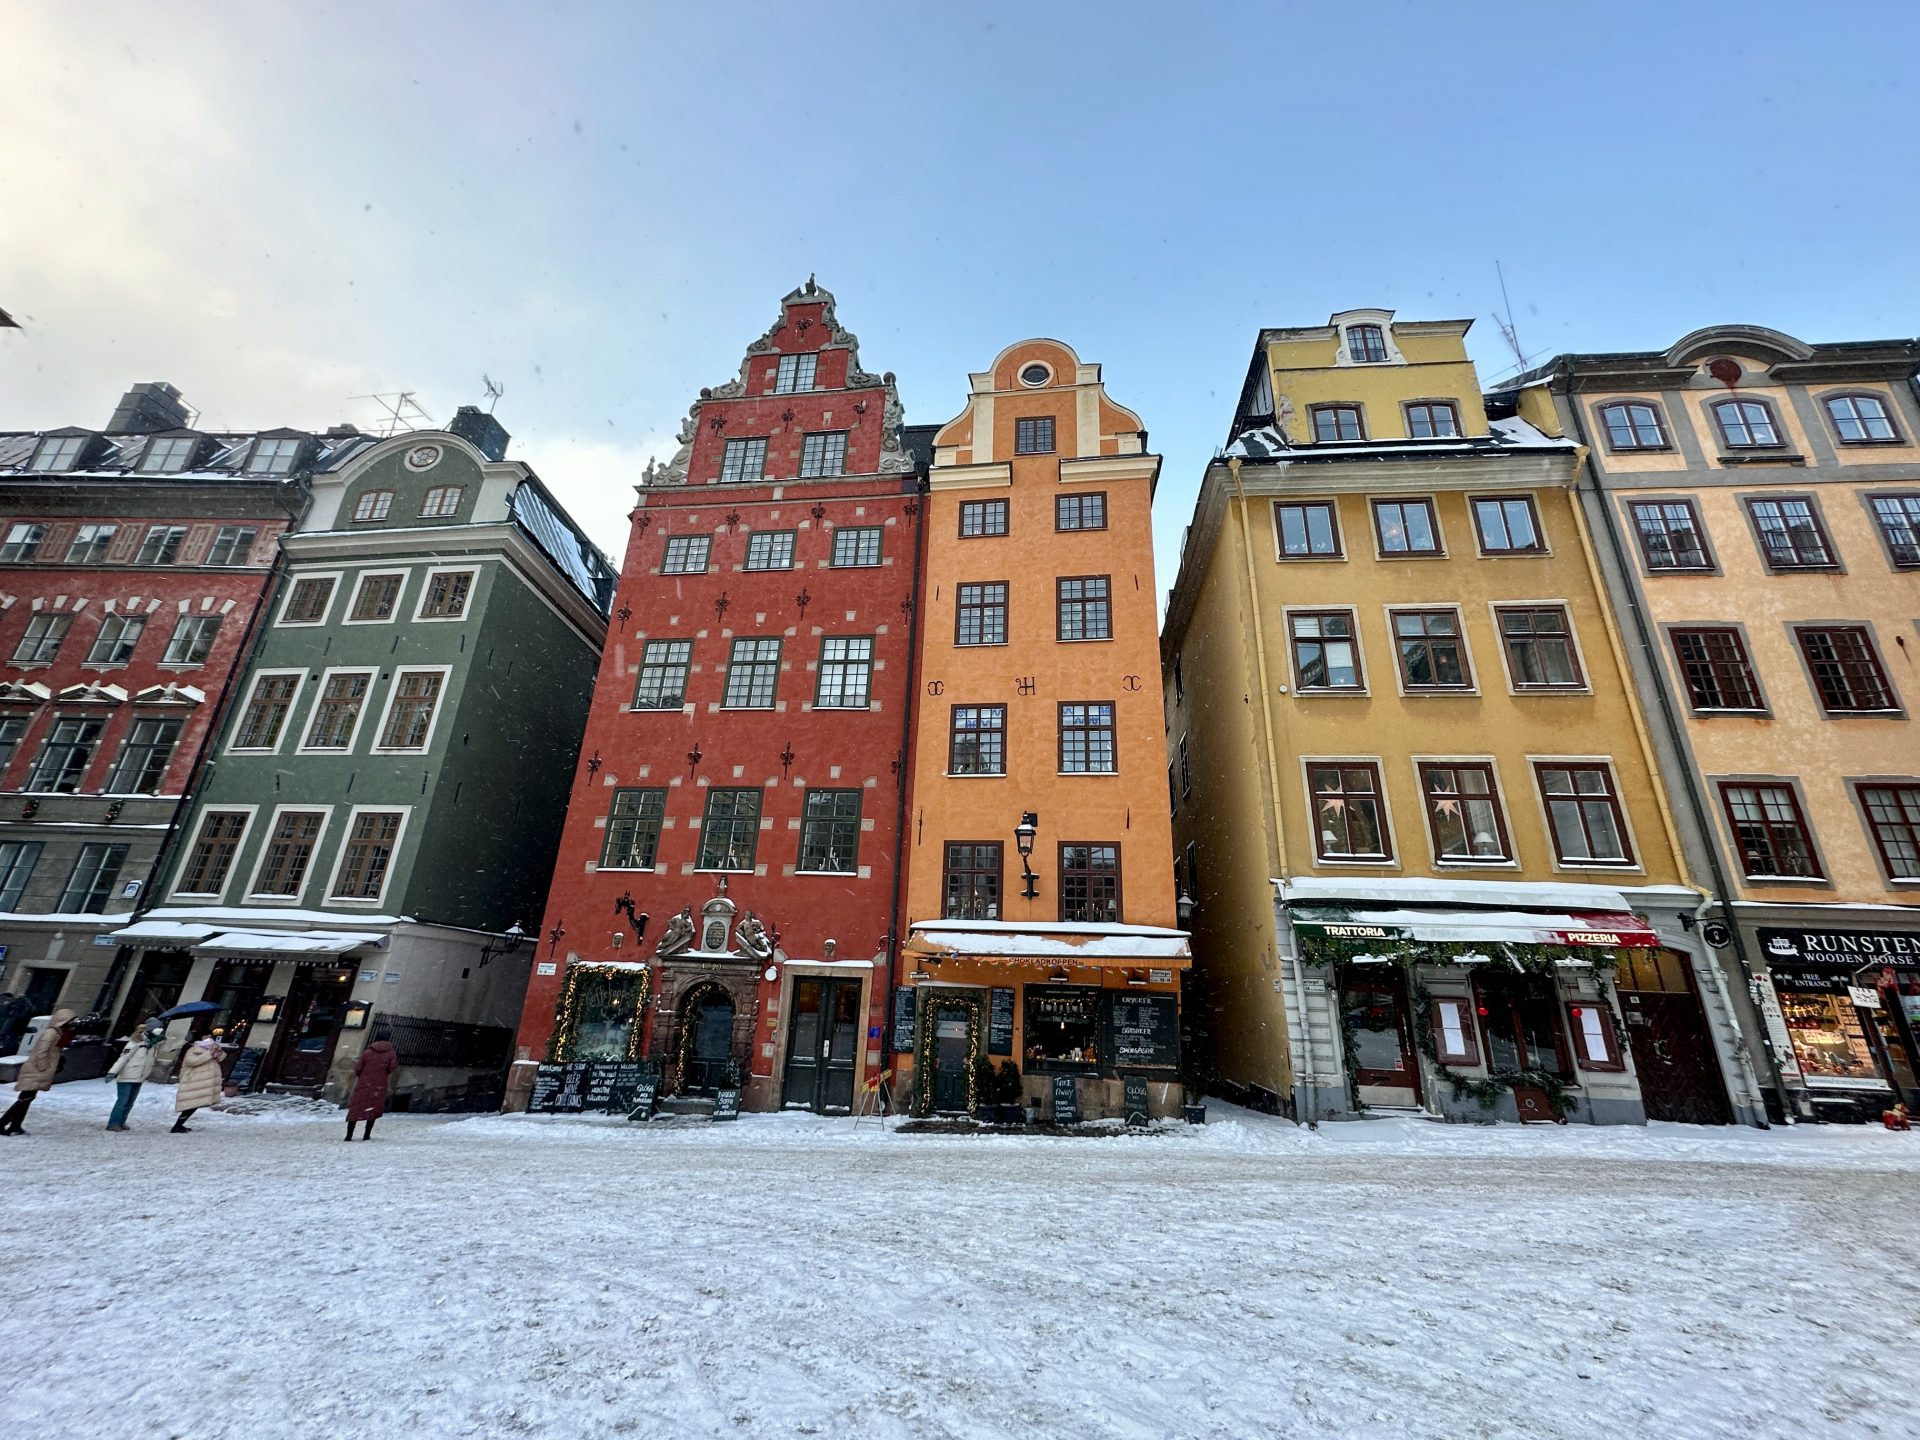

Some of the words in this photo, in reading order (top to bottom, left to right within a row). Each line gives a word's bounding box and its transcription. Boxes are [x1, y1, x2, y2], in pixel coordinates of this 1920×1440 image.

[1324, 926, 1386, 937] TRATTORIA
[1567, 932, 1621, 944] PIZZERIA
[1804, 952, 1864, 963] WOODEN
[1869, 955, 1916, 965] HORSE
